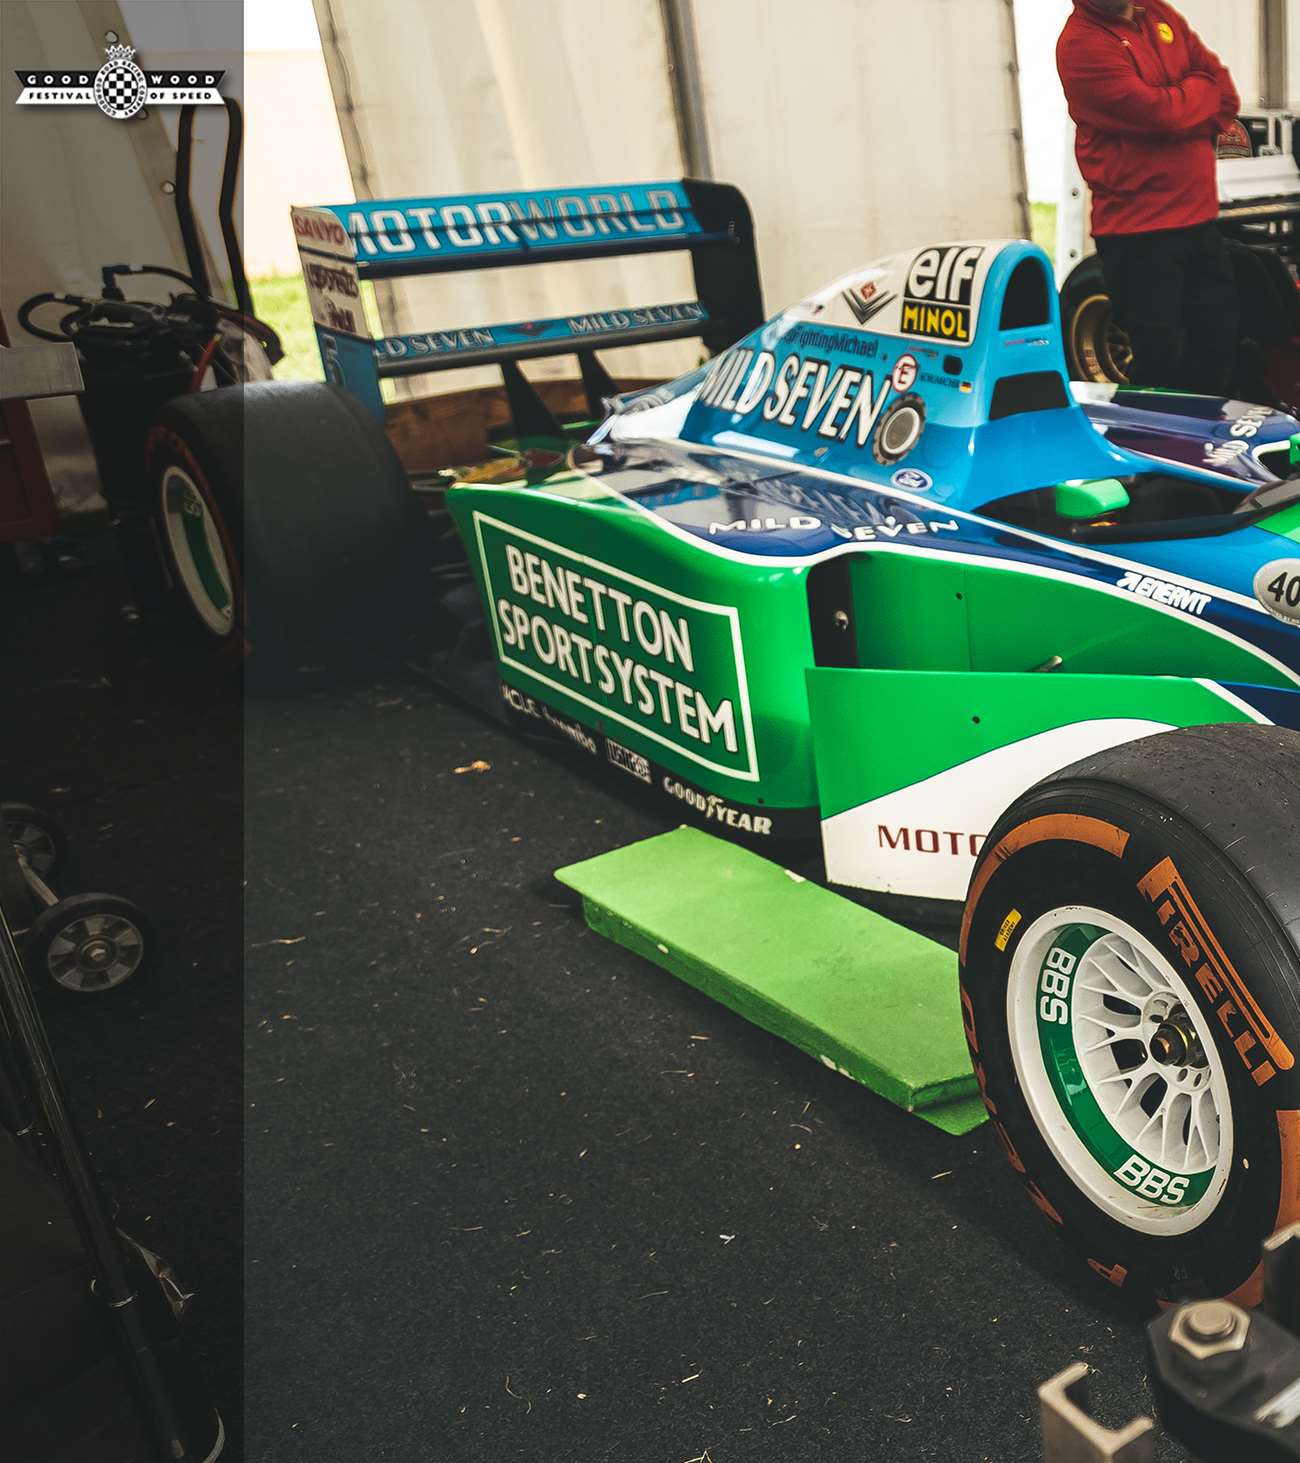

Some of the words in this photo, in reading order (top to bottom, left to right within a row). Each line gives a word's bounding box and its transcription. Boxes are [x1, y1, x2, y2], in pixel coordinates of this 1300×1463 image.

[295, 216, 345, 244] SANYO
[908, 246, 985, 299] elf
[375, 336, 407, 358] LD
[410, 329, 497, 354] SEVEN
[902, 306, 968, 341] MINOL
[700, 348, 778, 416] MILD
[762, 354, 893, 449] SEVEN
[896, 362, 917, 385] E
[708, 515, 823, 536] MILD
[830, 516, 961, 542] SEVEN
[504, 543, 696, 674] BENETTON
[496, 598, 740, 754] SPORTSYSTEM
[663, 776, 773, 836] GOODYEAR
[877, 824, 988, 858] MOTO
[1040, 946, 1076, 1025] BBS
[1113, 1154, 1189, 1206] BBS
